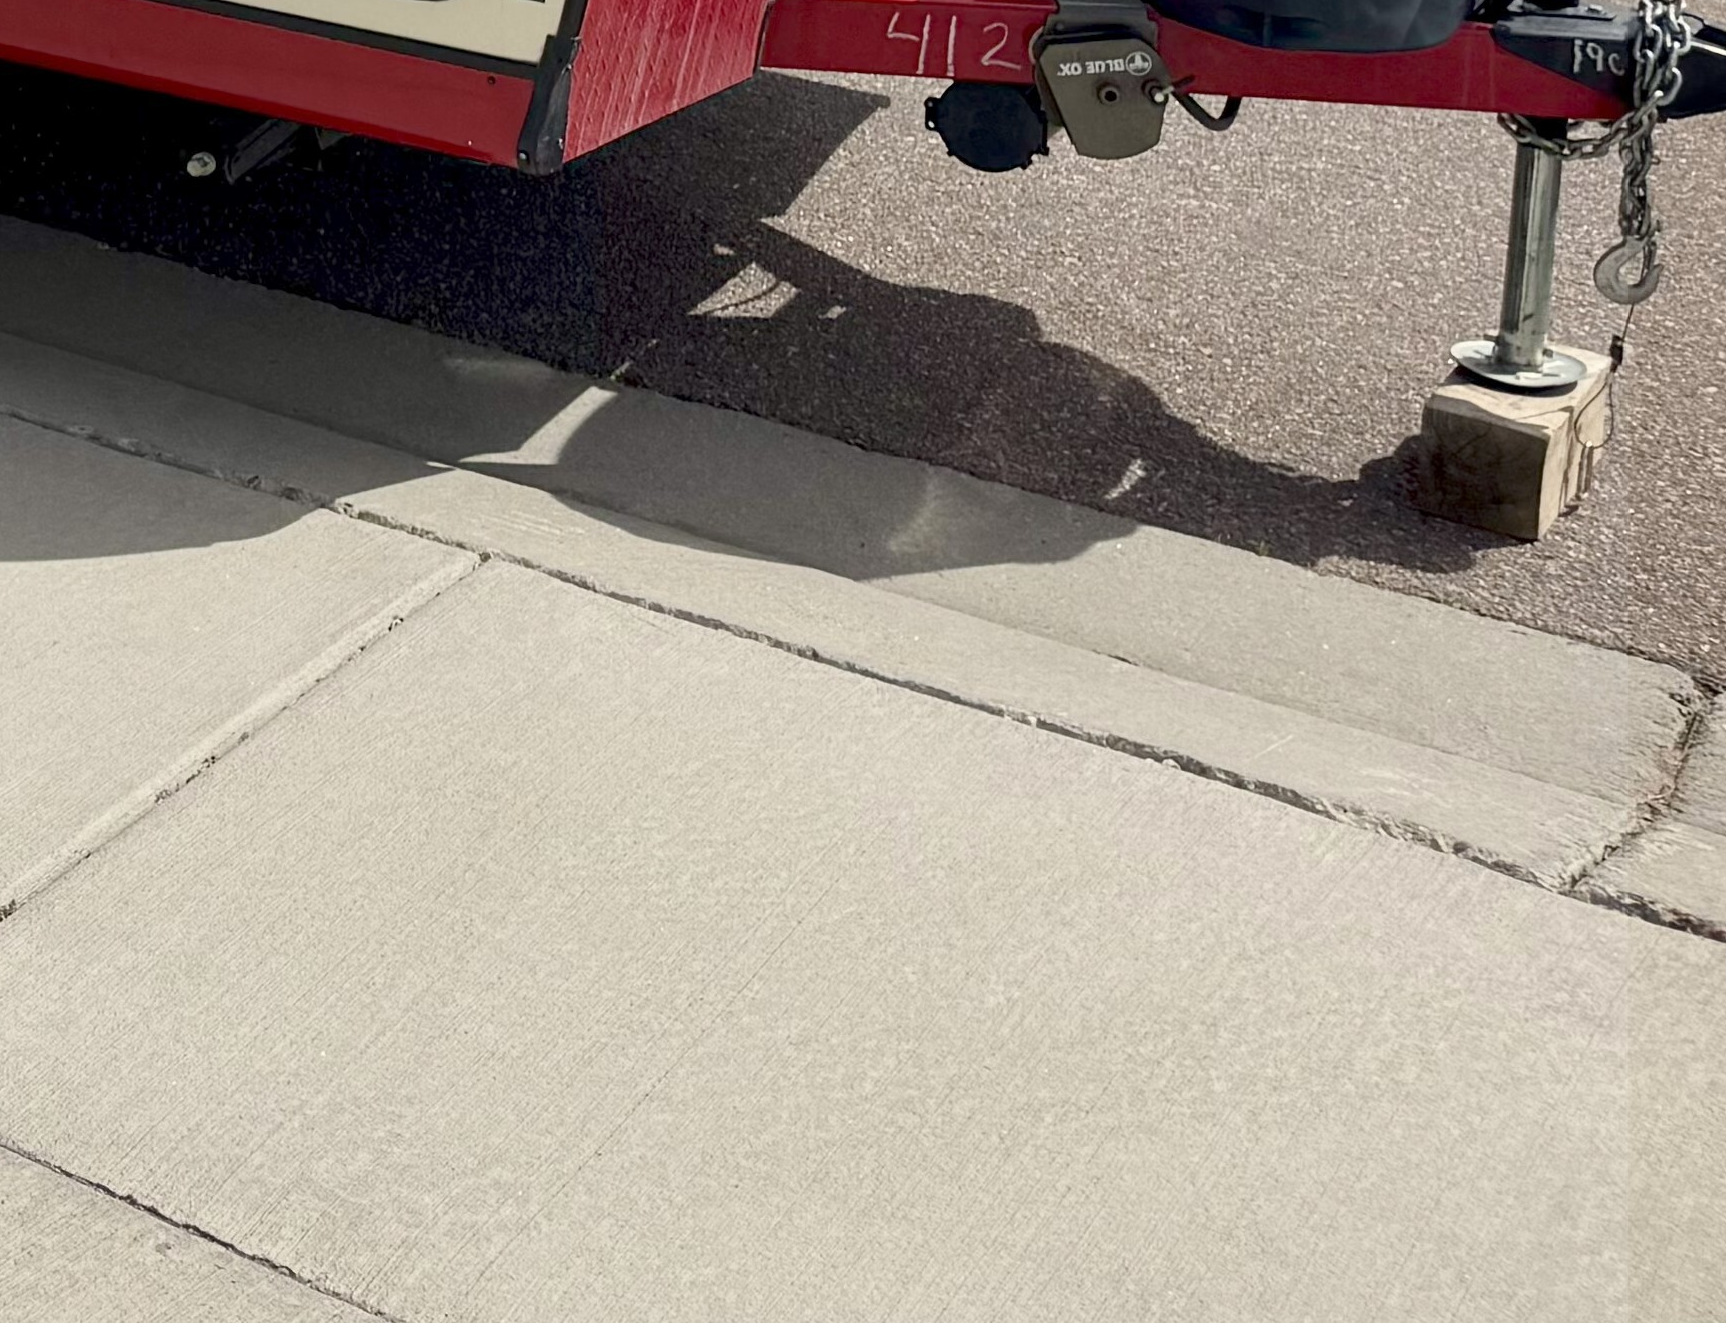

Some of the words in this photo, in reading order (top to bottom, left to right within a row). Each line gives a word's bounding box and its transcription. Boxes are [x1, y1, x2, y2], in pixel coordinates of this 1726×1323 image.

[887, 12, 1021, 77] 412
[1058, 62, 1082, 76] OX
[1085, 58, 1125, 74] BLUE
